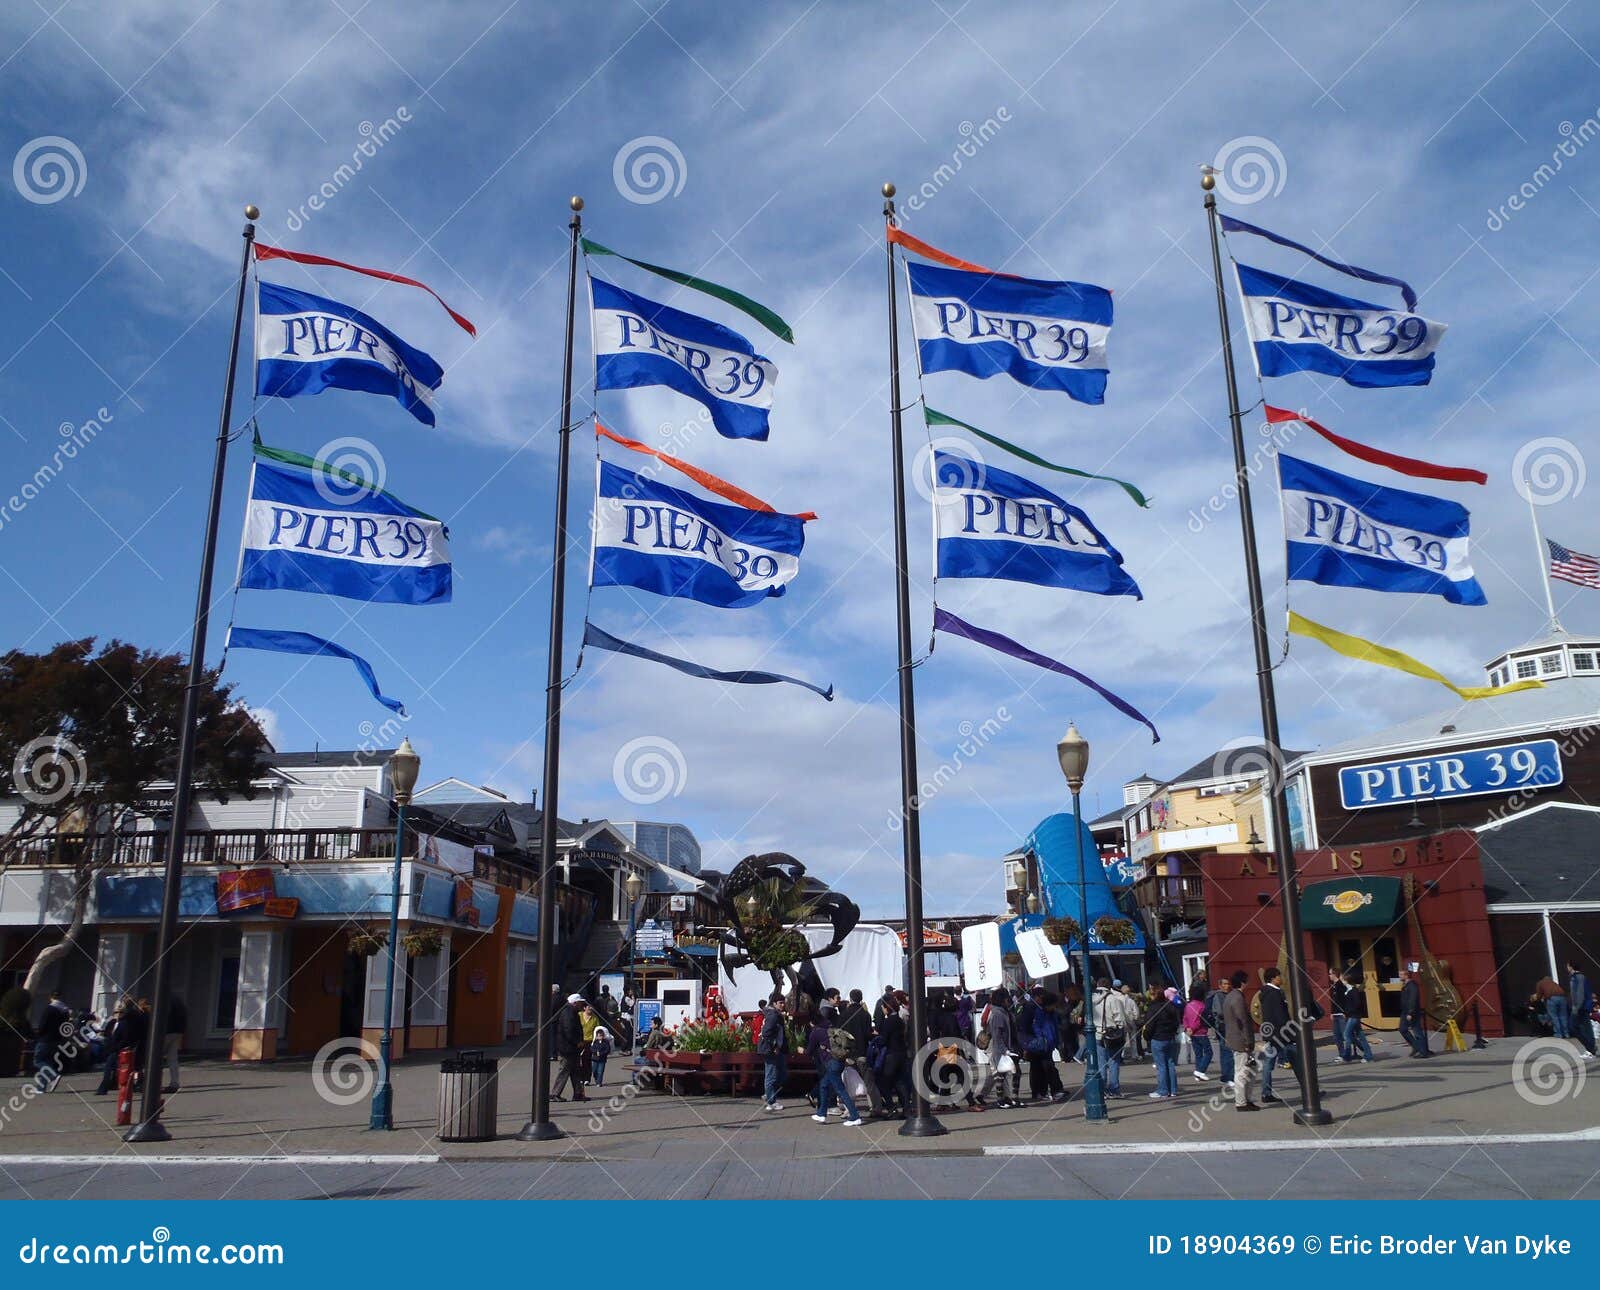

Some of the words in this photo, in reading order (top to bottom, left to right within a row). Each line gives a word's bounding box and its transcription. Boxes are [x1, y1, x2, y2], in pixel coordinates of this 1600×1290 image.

[281, 316, 379, 360] PIER
[934, 302, 1040, 359] PIER
[1044, 324, 1089, 363] 39
[1264, 301, 1366, 355] PIER
[1370, 315, 1427, 355] 39
[616, 314, 712, 389] PIER
[715, 356, 765, 399] 39
[269, 506, 386, 559] PIER
[387, 519, 427, 560] 39
[622, 504, 725, 564] PIER
[731, 548, 779, 588] 39
[960, 493, 1078, 545] PIER
[1304, 497, 1405, 563] PIER
[1403, 535, 1448, 571] 39
[1356, 758, 1472, 802] PIER
[1485, 749, 1537, 787] 39
[1240, 856, 1302, 876] AL
[1330, 850, 1364, 871] IS
